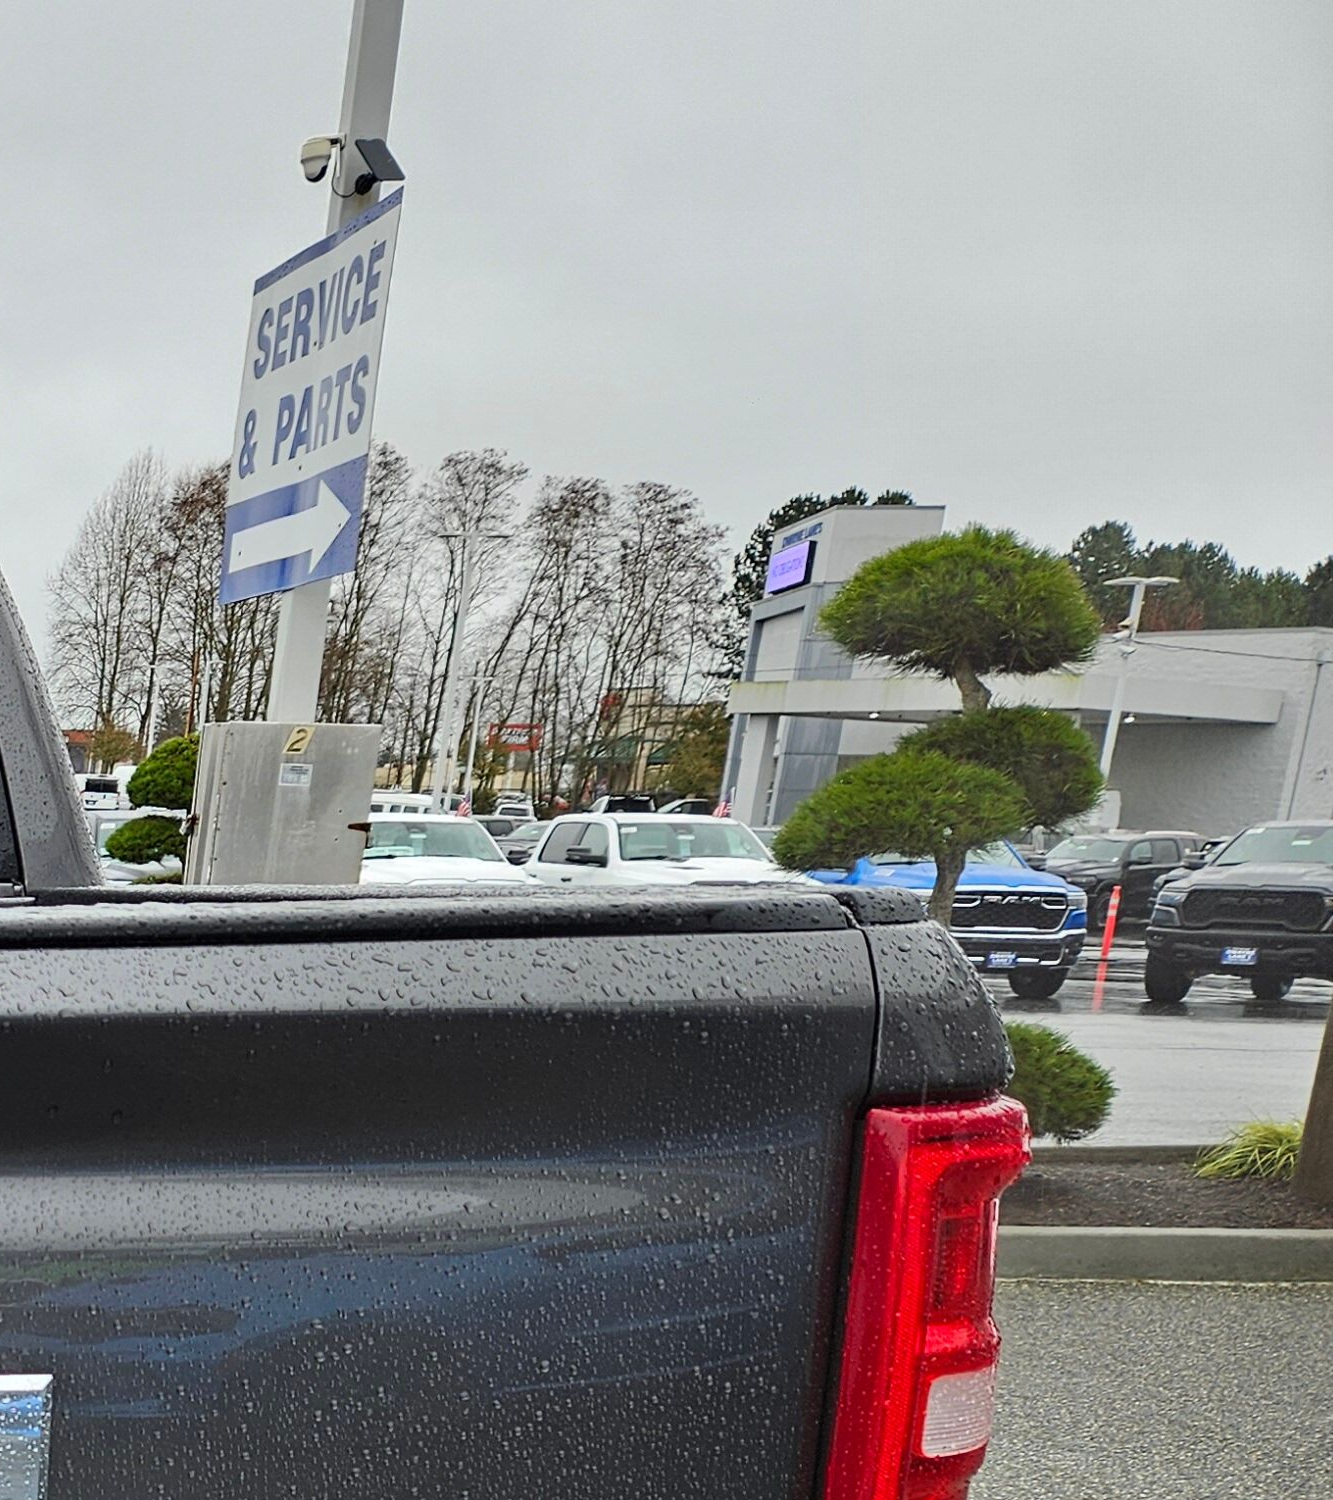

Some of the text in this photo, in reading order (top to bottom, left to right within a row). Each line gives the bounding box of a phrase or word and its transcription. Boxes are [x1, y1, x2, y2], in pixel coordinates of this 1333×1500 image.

[253, 240, 387, 380] SERVICE
[238, 354, 370, 480] & PARTS
[286, 728, 309, 752] 2
